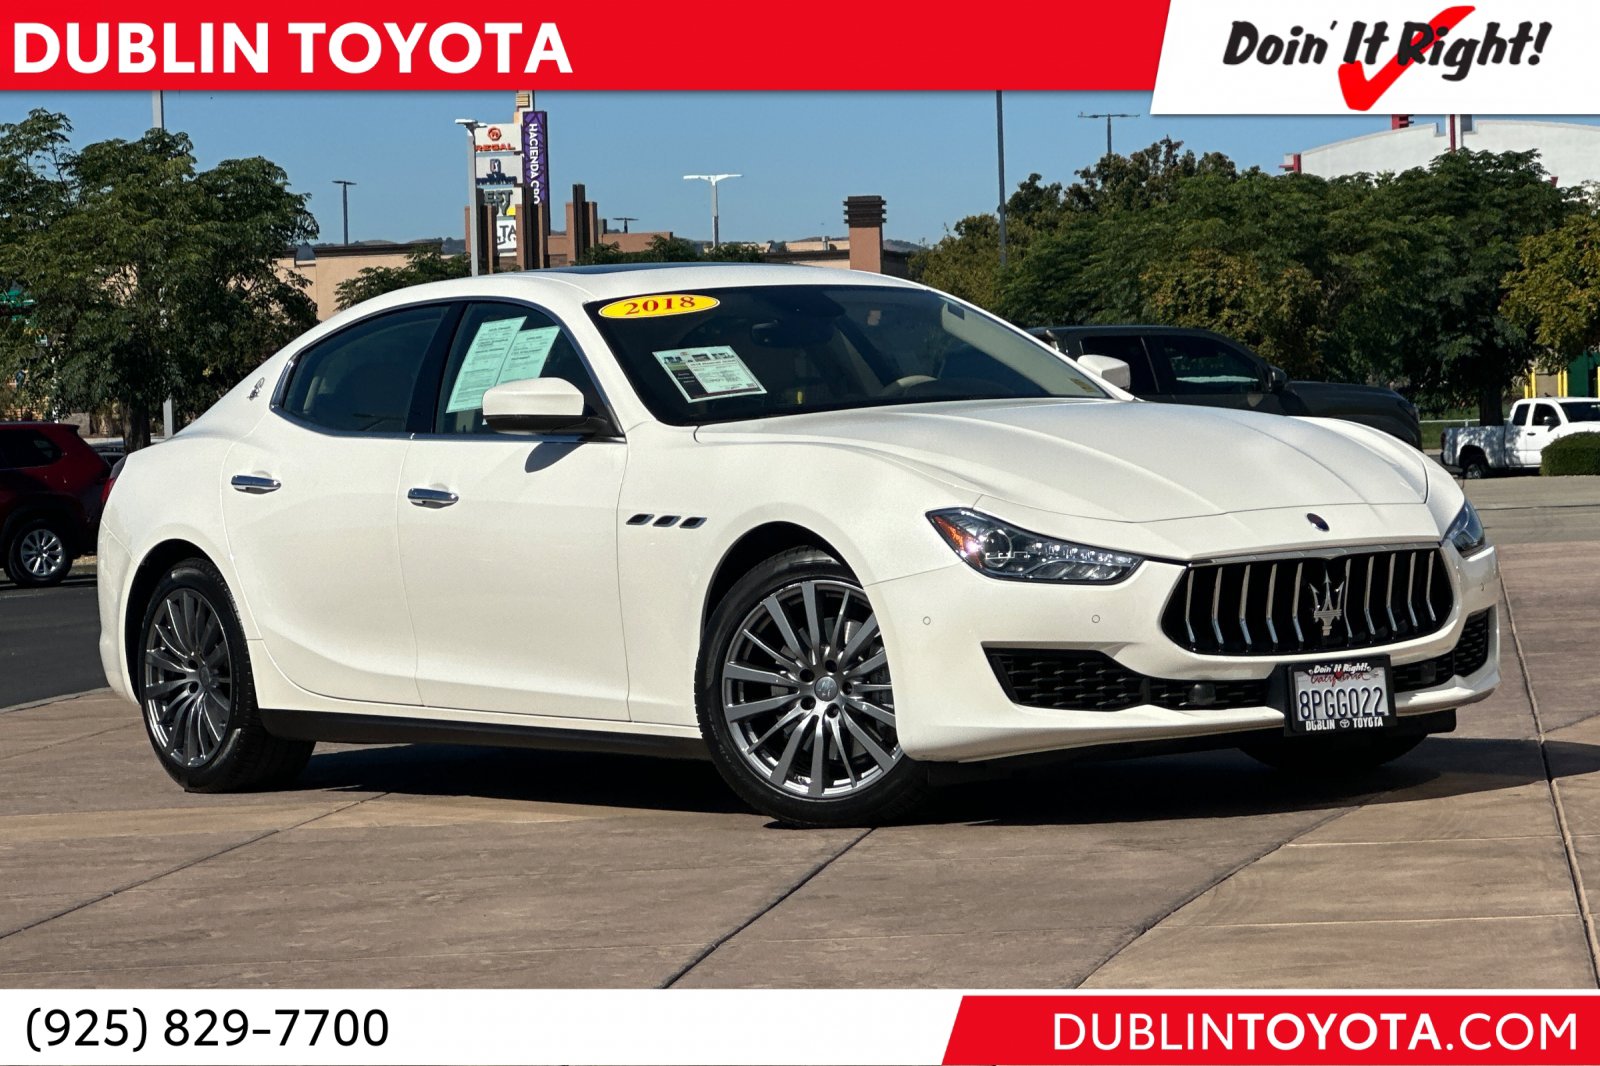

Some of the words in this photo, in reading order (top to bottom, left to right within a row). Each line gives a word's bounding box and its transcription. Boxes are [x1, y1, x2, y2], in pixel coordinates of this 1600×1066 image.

[529, 123, 539, 178] HACIENDA
[484, 189, 513, 204] EST
[624, 296, 696, 315] 2018
[1333, 663, 1342, 673] It
[1342, 662, 1369, 674] Right!
[1299, 686, 1385, 720] 8PGG022
[1306, 719, 1335, 731] DUBLIN
[1353, 716, 1383, 728] TOYOTA
